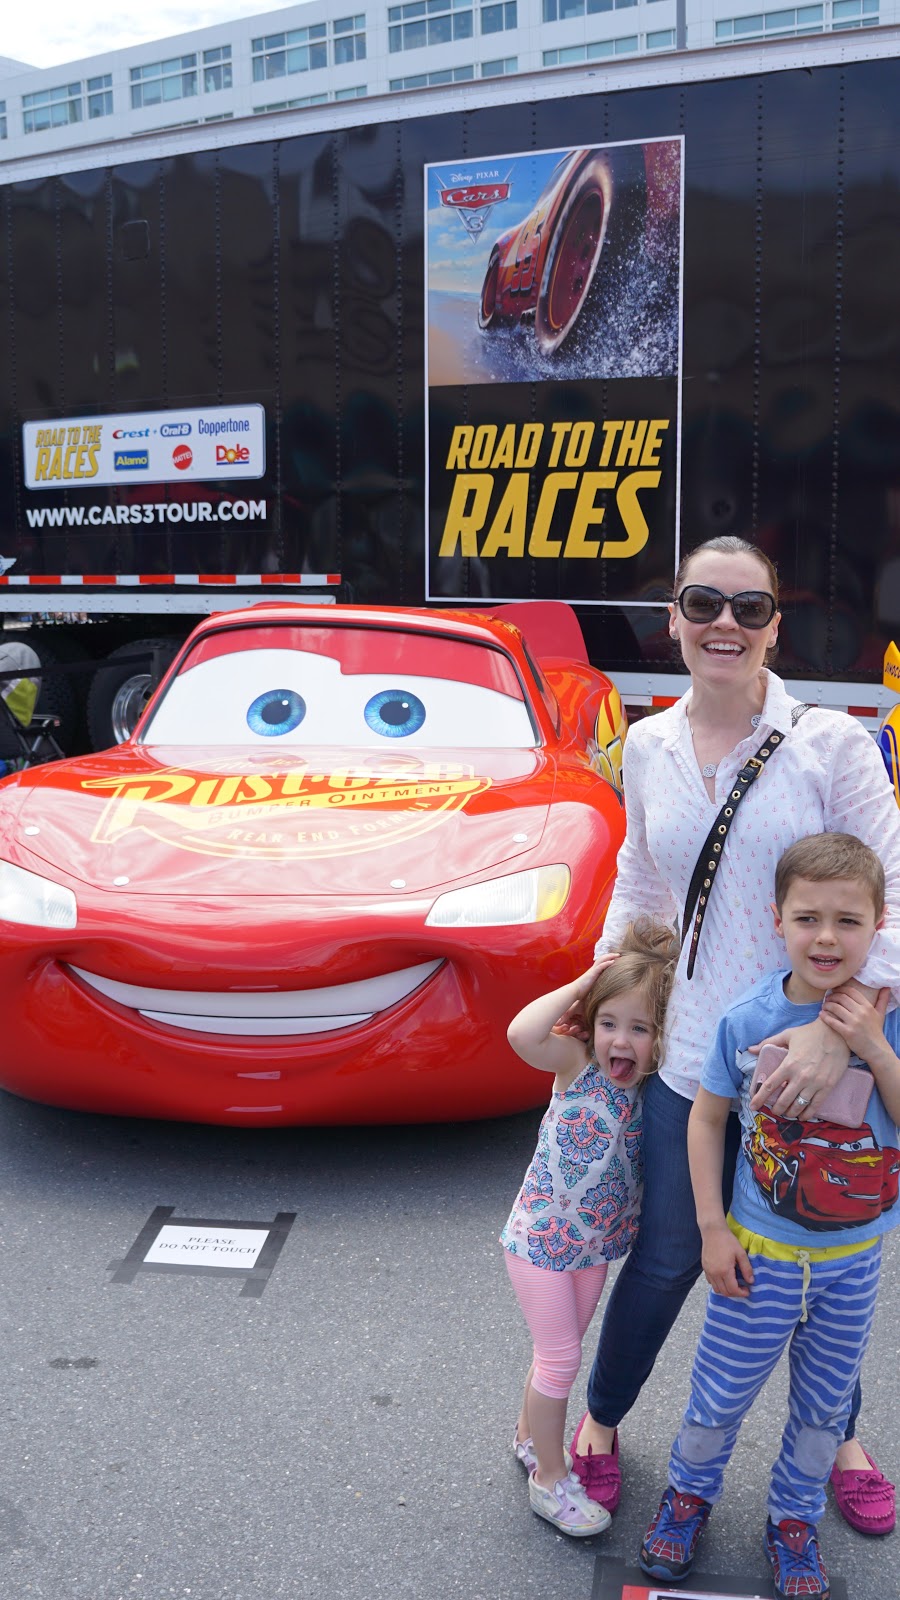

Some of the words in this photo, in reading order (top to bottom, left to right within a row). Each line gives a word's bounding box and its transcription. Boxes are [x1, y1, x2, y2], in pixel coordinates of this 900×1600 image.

[449, 173, 473, 183] Disney
[476, 170, 499, 179] PIXAR
[446, 189, 501, 204] Cars
[467, 214, 483, 233] 3
[36, 428, 66, 448] ROAD
[67, 426, 81, 446] TO
[83, 425, 103, 444] THE
[112, 427, 150, 440] Crest
[161, 423, 190, 437] Oral-B
[198, 418, 249, 437] Coppertone
[116, 455, 148, 466] Alamo
[172, 451, 193, 464] MATTEL
[215, 443, 250, 463] Dole
[445, 423, 545, 470] ROAD
[548, 421, 596, 468] TO
[598, 419, 670, 467] THE
[35, 444, 101, 481] RACES
[26, 500, 267, 528] WWW.CARS3TOUR.COM
[438, 470, 662, 559] RACES
[208, 799, 311, 824] BUMPER
[328, 785, 454, 804] OINTMENT
[227, 828, 283, 843] REAR
[297, 830, 340, 843] END
[349, 801, 432, 836] FORMULA
[188, 1237, 236, 1245] PLEASE
[213, 1246, 257, 1254] TOUCH
